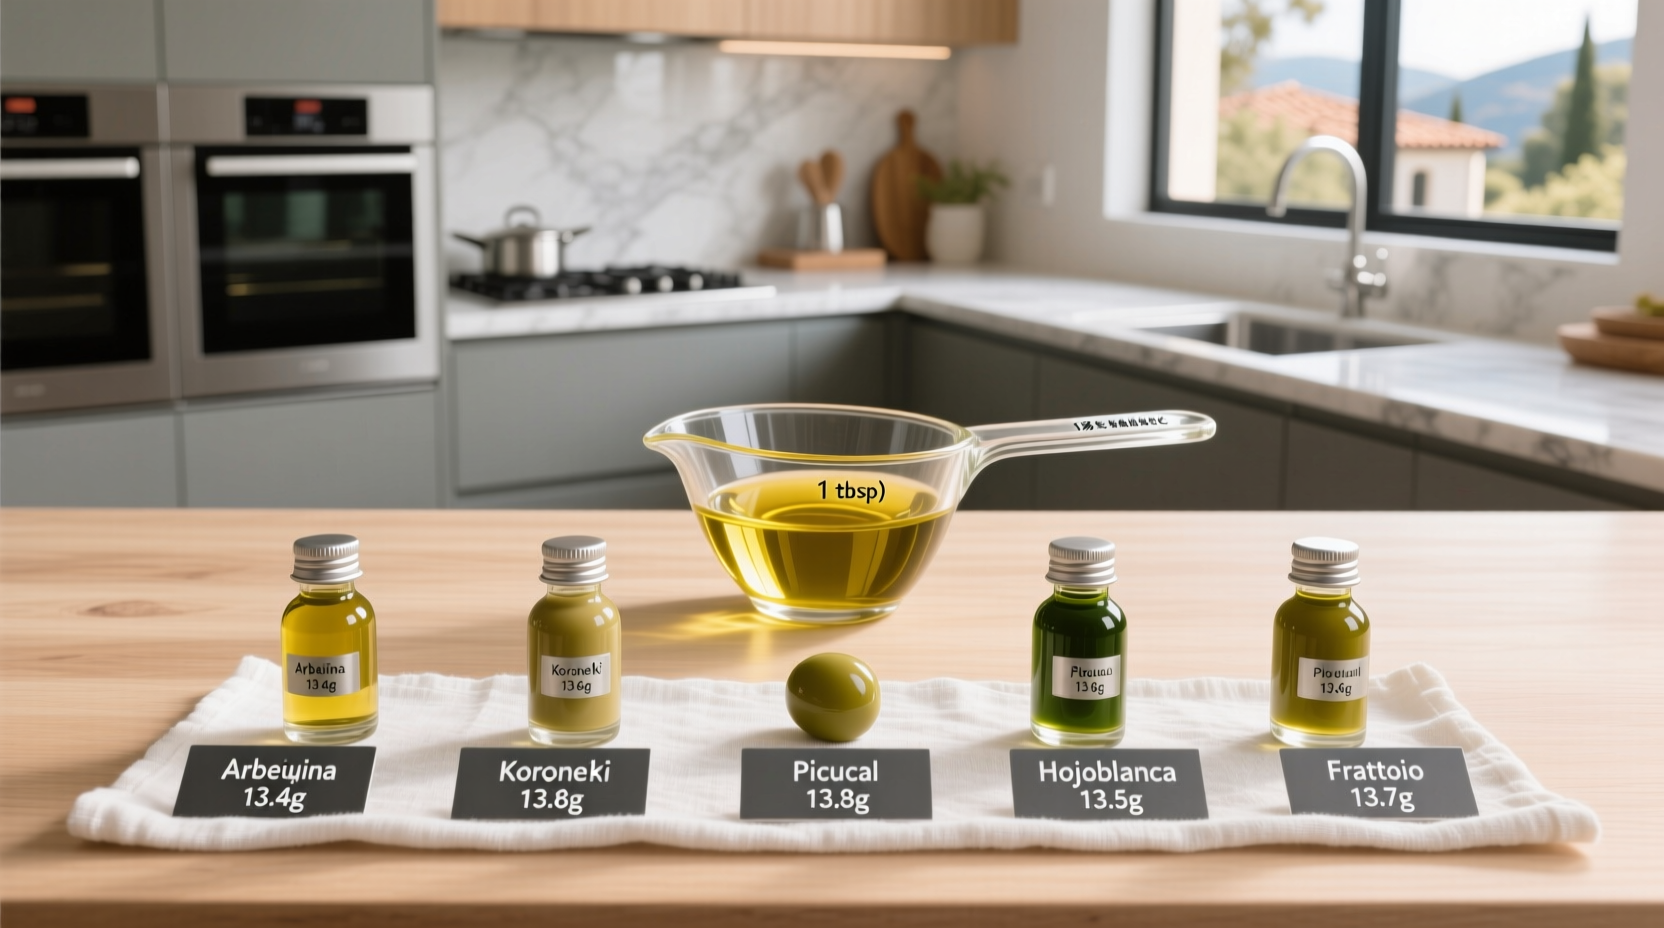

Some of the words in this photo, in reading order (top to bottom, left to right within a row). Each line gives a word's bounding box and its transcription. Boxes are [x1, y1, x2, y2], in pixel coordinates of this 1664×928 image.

[818, 480, 826, 499] 1
[835, 480, 885, 504] tbsp)
[499, 759, 611, 782] Koroneki
[794, 759, 878, 782] Picucal
[1039, 759, 1176, 788] Hojoblanca
[1327, 759, 1424, 781] Frattoio
[244, 786, 307, 813] 13.4g
[521, 788, 584, 815] 13.8g
[807, 788, 870, 815] 13.8g
[1080, 789, 1144, 816] 13.5g
[1351, 787, 1415, 813] 13.7g
